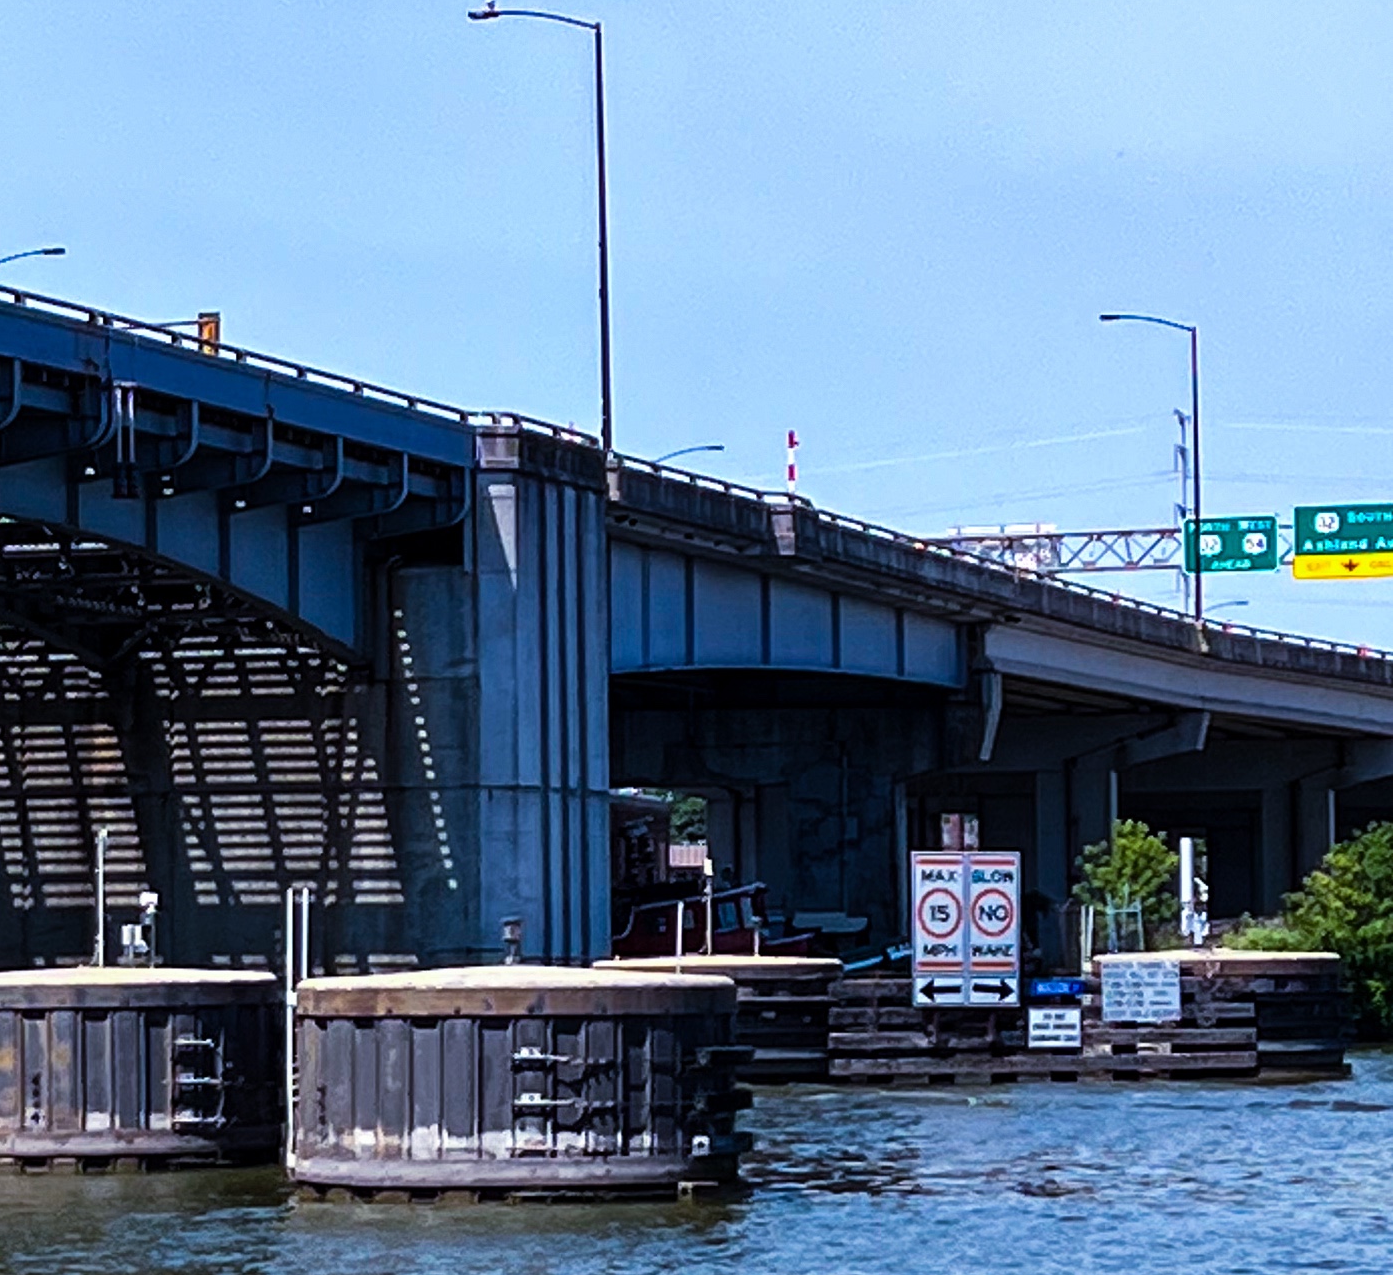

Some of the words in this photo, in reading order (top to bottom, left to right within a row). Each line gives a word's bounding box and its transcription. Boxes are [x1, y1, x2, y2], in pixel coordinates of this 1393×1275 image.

[1346, 511, 1393, 523] SOUTH
[1237, 520, 1273, 531] WEST
[1302, 538, 1369, 551] Ashland
[921, 869, 958, 882] MAX
[929, 905, 951, 922] 15
[978, 905, 1010, 922] NO
[922, 944, 958, 957] MPH
[971, 944, 1014, 957] WAKE
